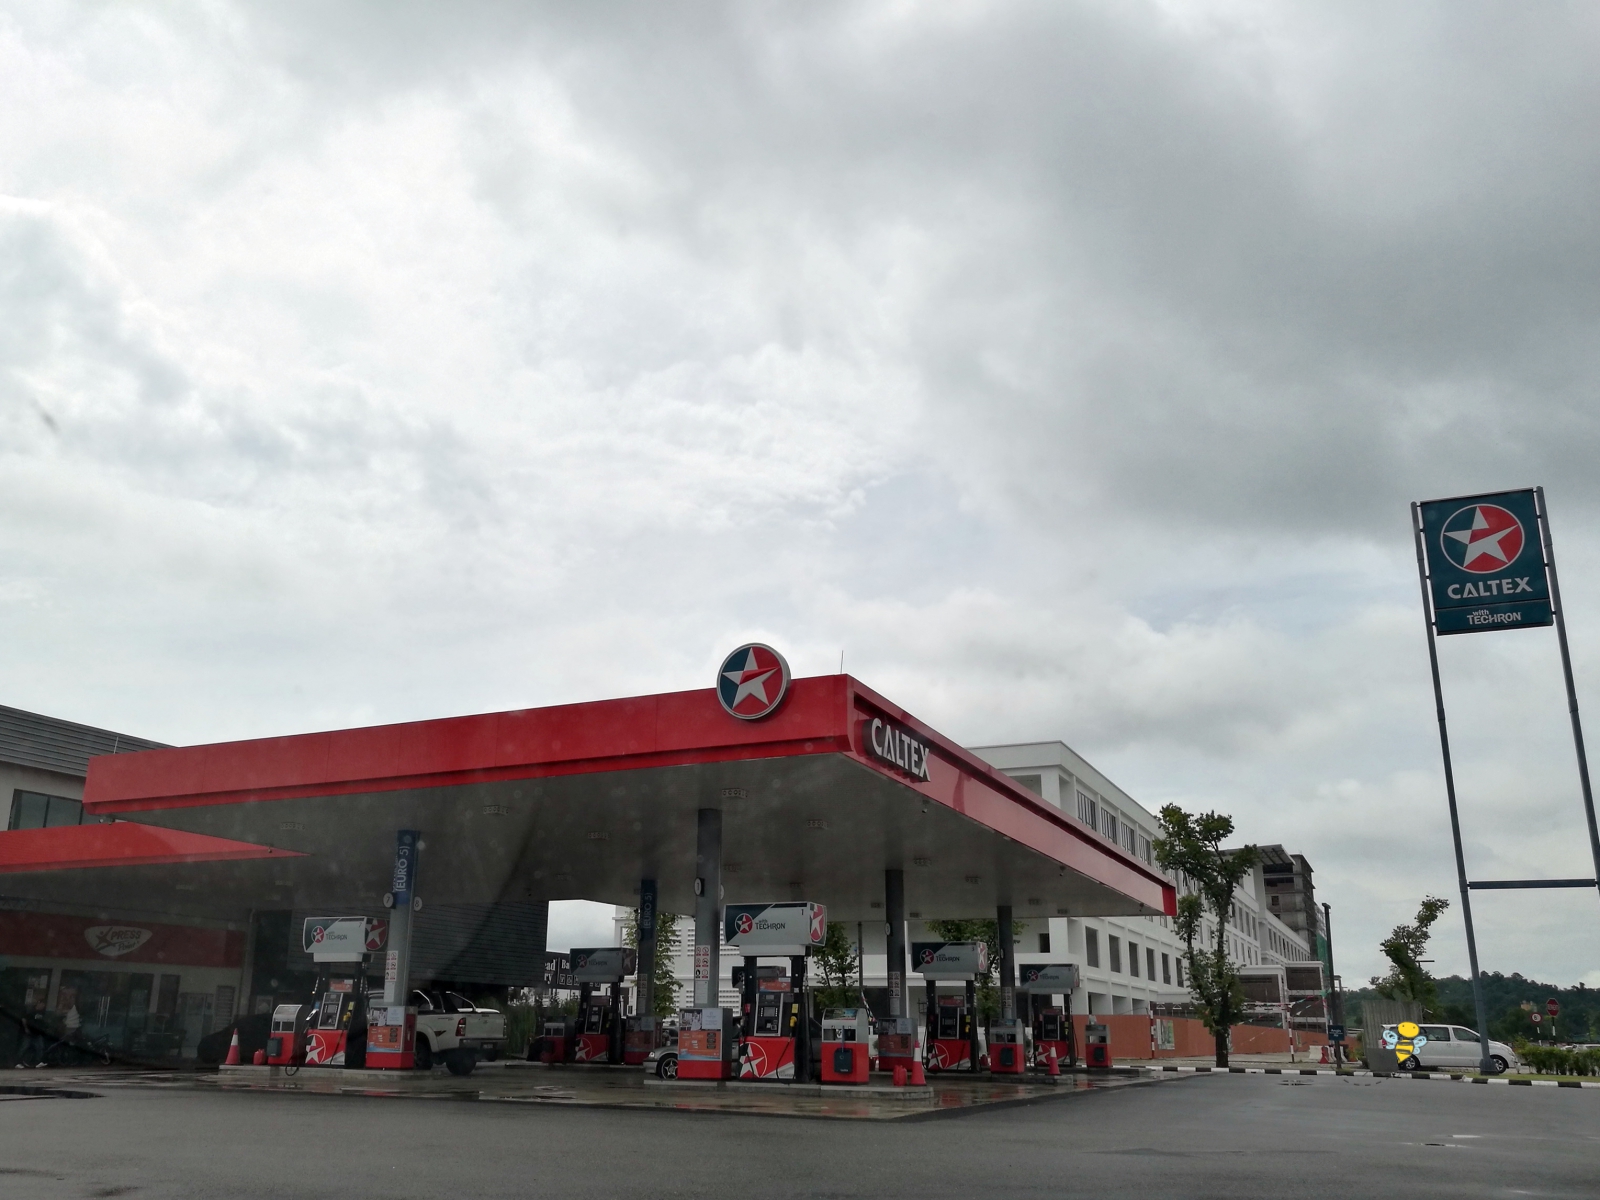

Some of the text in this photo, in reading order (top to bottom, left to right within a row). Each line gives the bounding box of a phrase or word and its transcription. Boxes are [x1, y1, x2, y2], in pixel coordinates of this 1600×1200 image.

[1447, 576, 1534, 600] CALTEX
[1466, 612, 1522, 625] TECHRON
[1472, 609, 1490, 617] with
[871, 717, 931, 782] CALTEX
[754, 922, 786, 931] TECHRON
